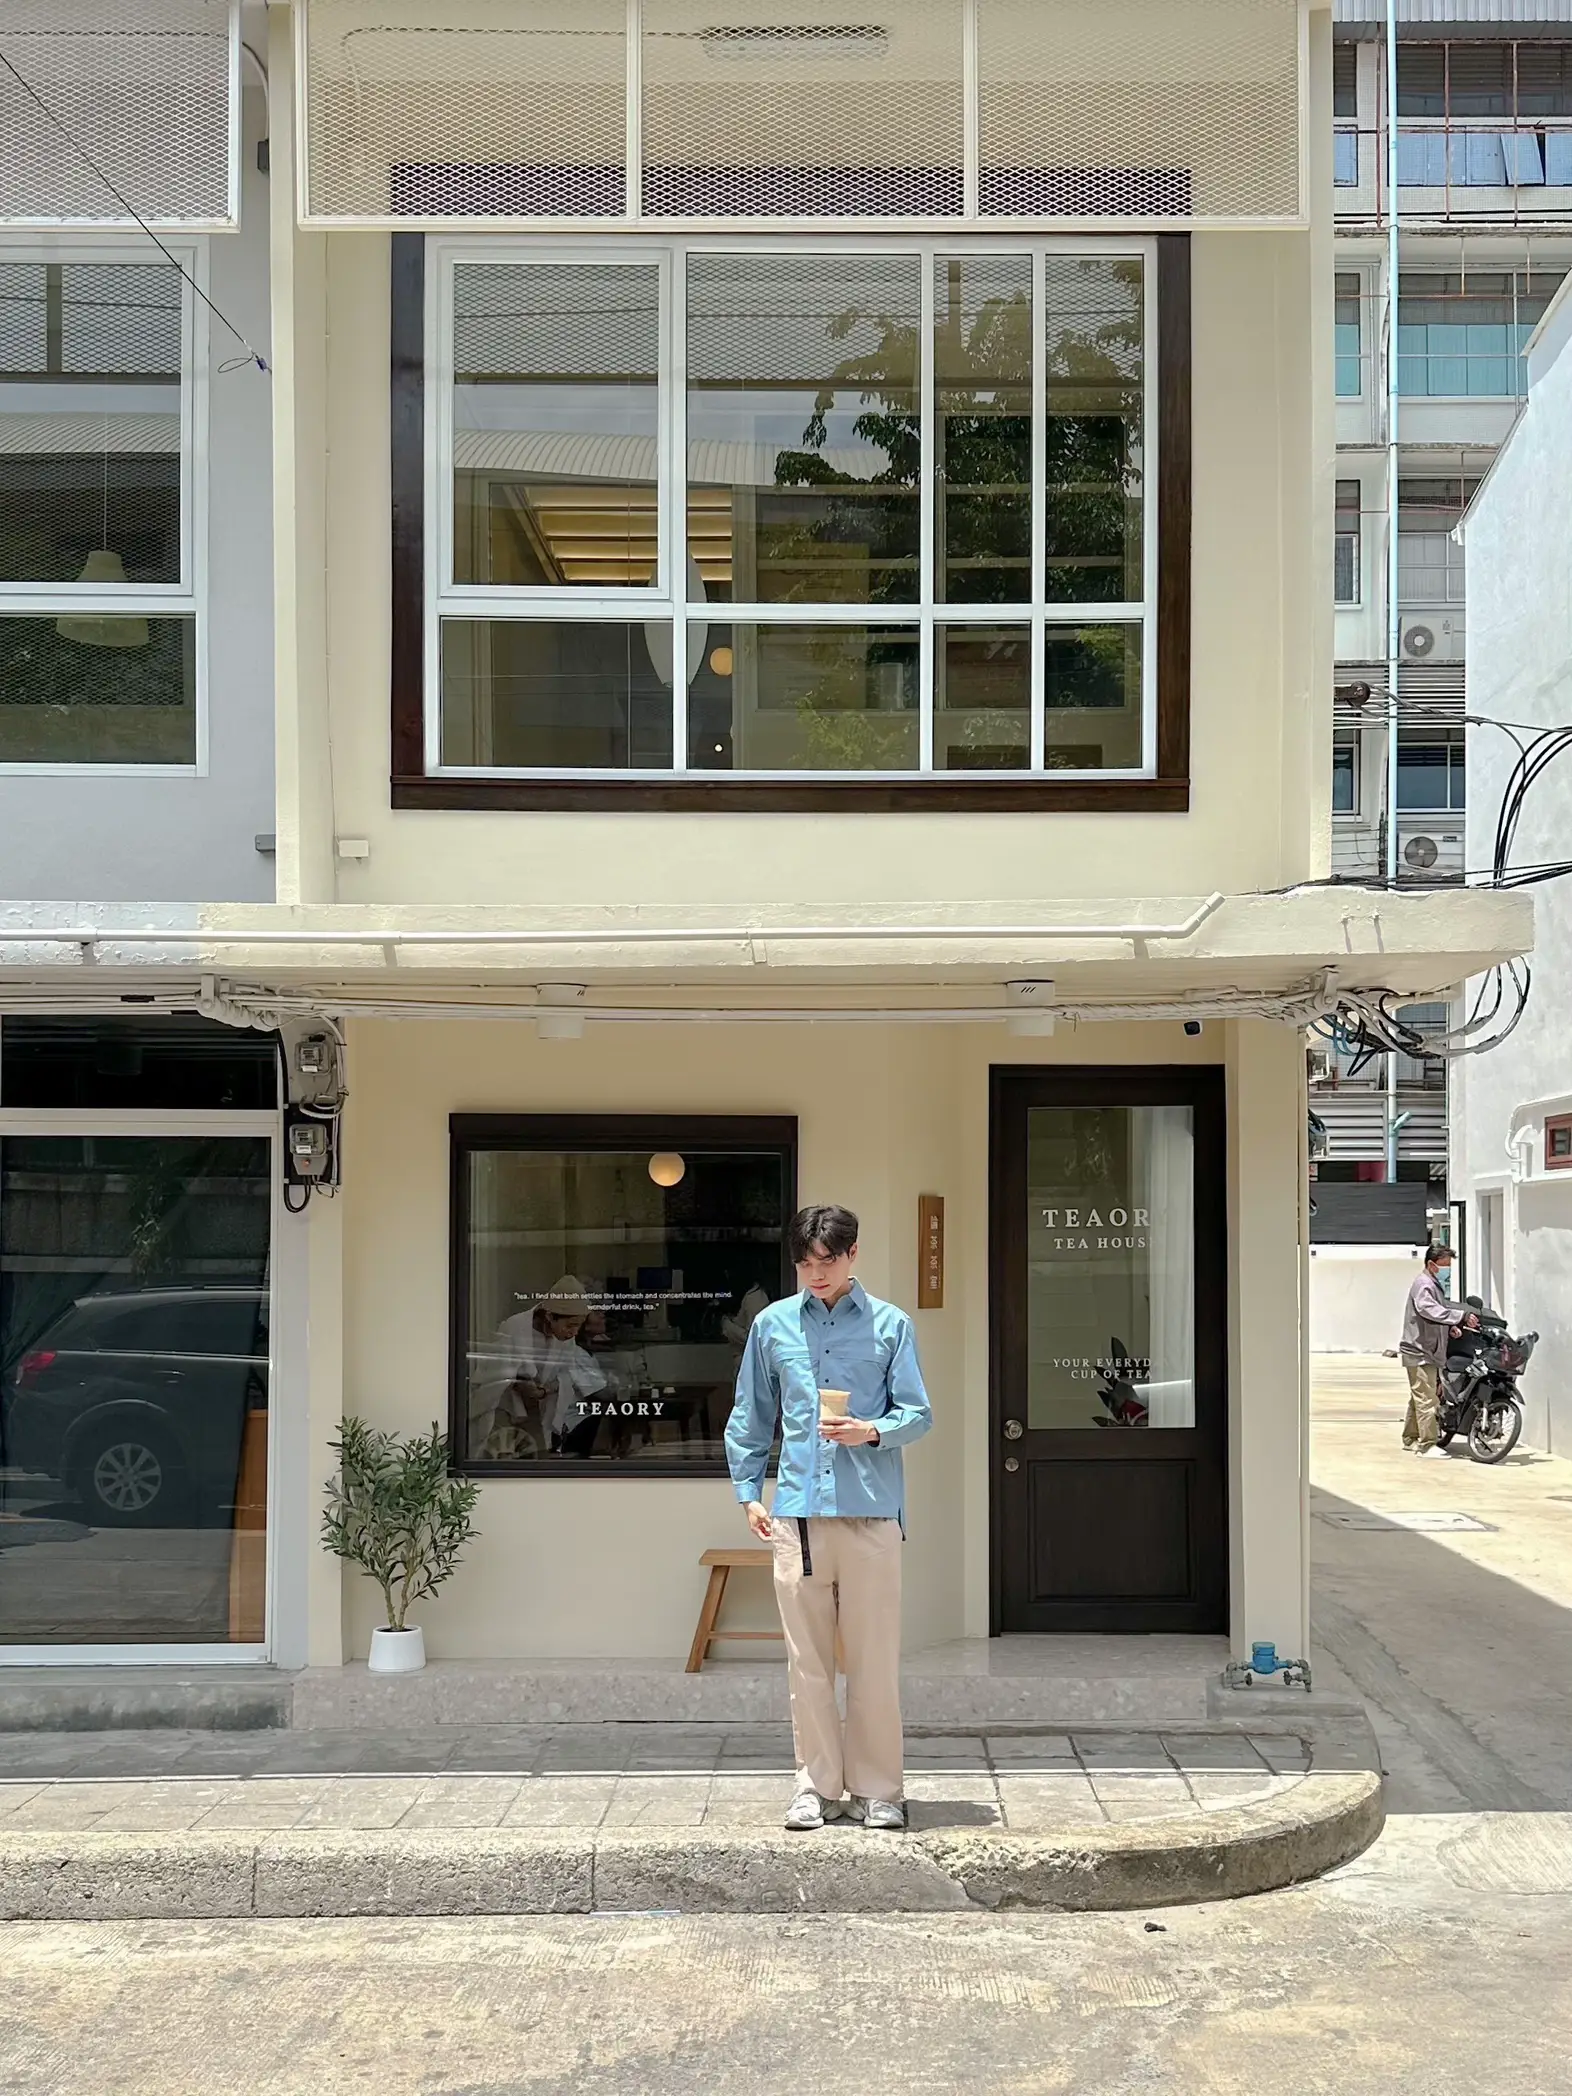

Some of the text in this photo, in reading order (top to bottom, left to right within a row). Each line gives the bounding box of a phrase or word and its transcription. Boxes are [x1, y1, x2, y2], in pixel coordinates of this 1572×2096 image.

[1042, 1208, 1150, 1227] TEAOR
[1054, 1237, 1152, 1249] TEA HOUS
[1053, 1358, 1152, 1368] YOUR EVERYD
[1071, 1369, 1153, 1379] CUP OF TEA
[576, 1402, 664, 1416] TEAORY
